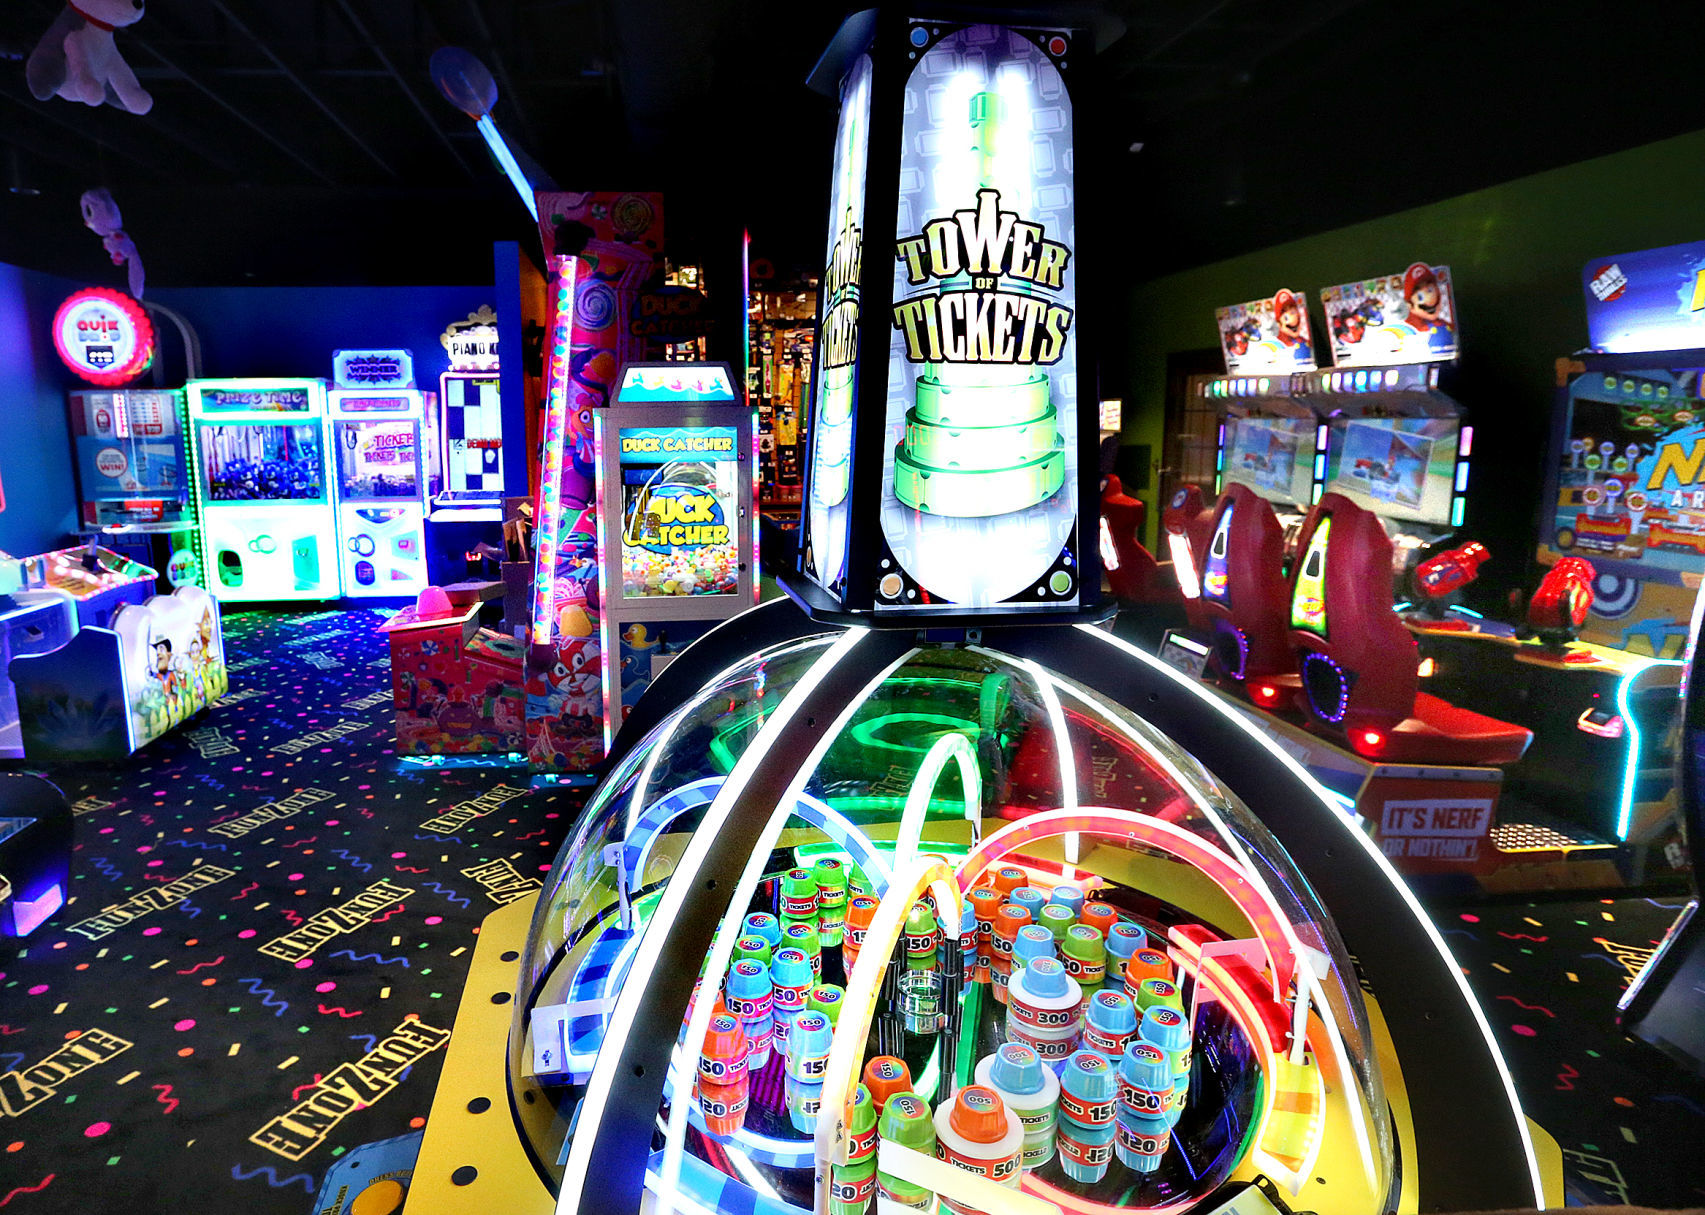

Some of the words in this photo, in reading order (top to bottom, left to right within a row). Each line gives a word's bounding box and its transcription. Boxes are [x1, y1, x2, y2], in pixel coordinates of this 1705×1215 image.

[897, 188, 1072, 290] TOWER
[975, 277, 994, 289] OF
[893, 292, 1074, 365] TICKETS
[453, 342, 485, 355] PIANO
[350, 366, 398, 374] WINNER
[622, 437, 661, 453] DUCK
[662, 437, 733, 453] CATCHER
[1388, 807, 1428, 829] IT'S
[1431, 807, 1484, 829] NERF
[991, 935, 1013, 952] 150
[728, 999, 754, 1014] 150
[1038, 1013, 1068, 1025] 300
[1088, 1031, 1115, 1047] TICKETS
[1136, 1048, 1158, 1058] 150
[883, 1062, 893, 1078] 150
[1124, 1088, 1160, 1109] 150
[900, 1100, 917, 1116] 150
[950, 1158, 986, 1175] TICKETS
[994, 1153, 1021, 1177] 500
